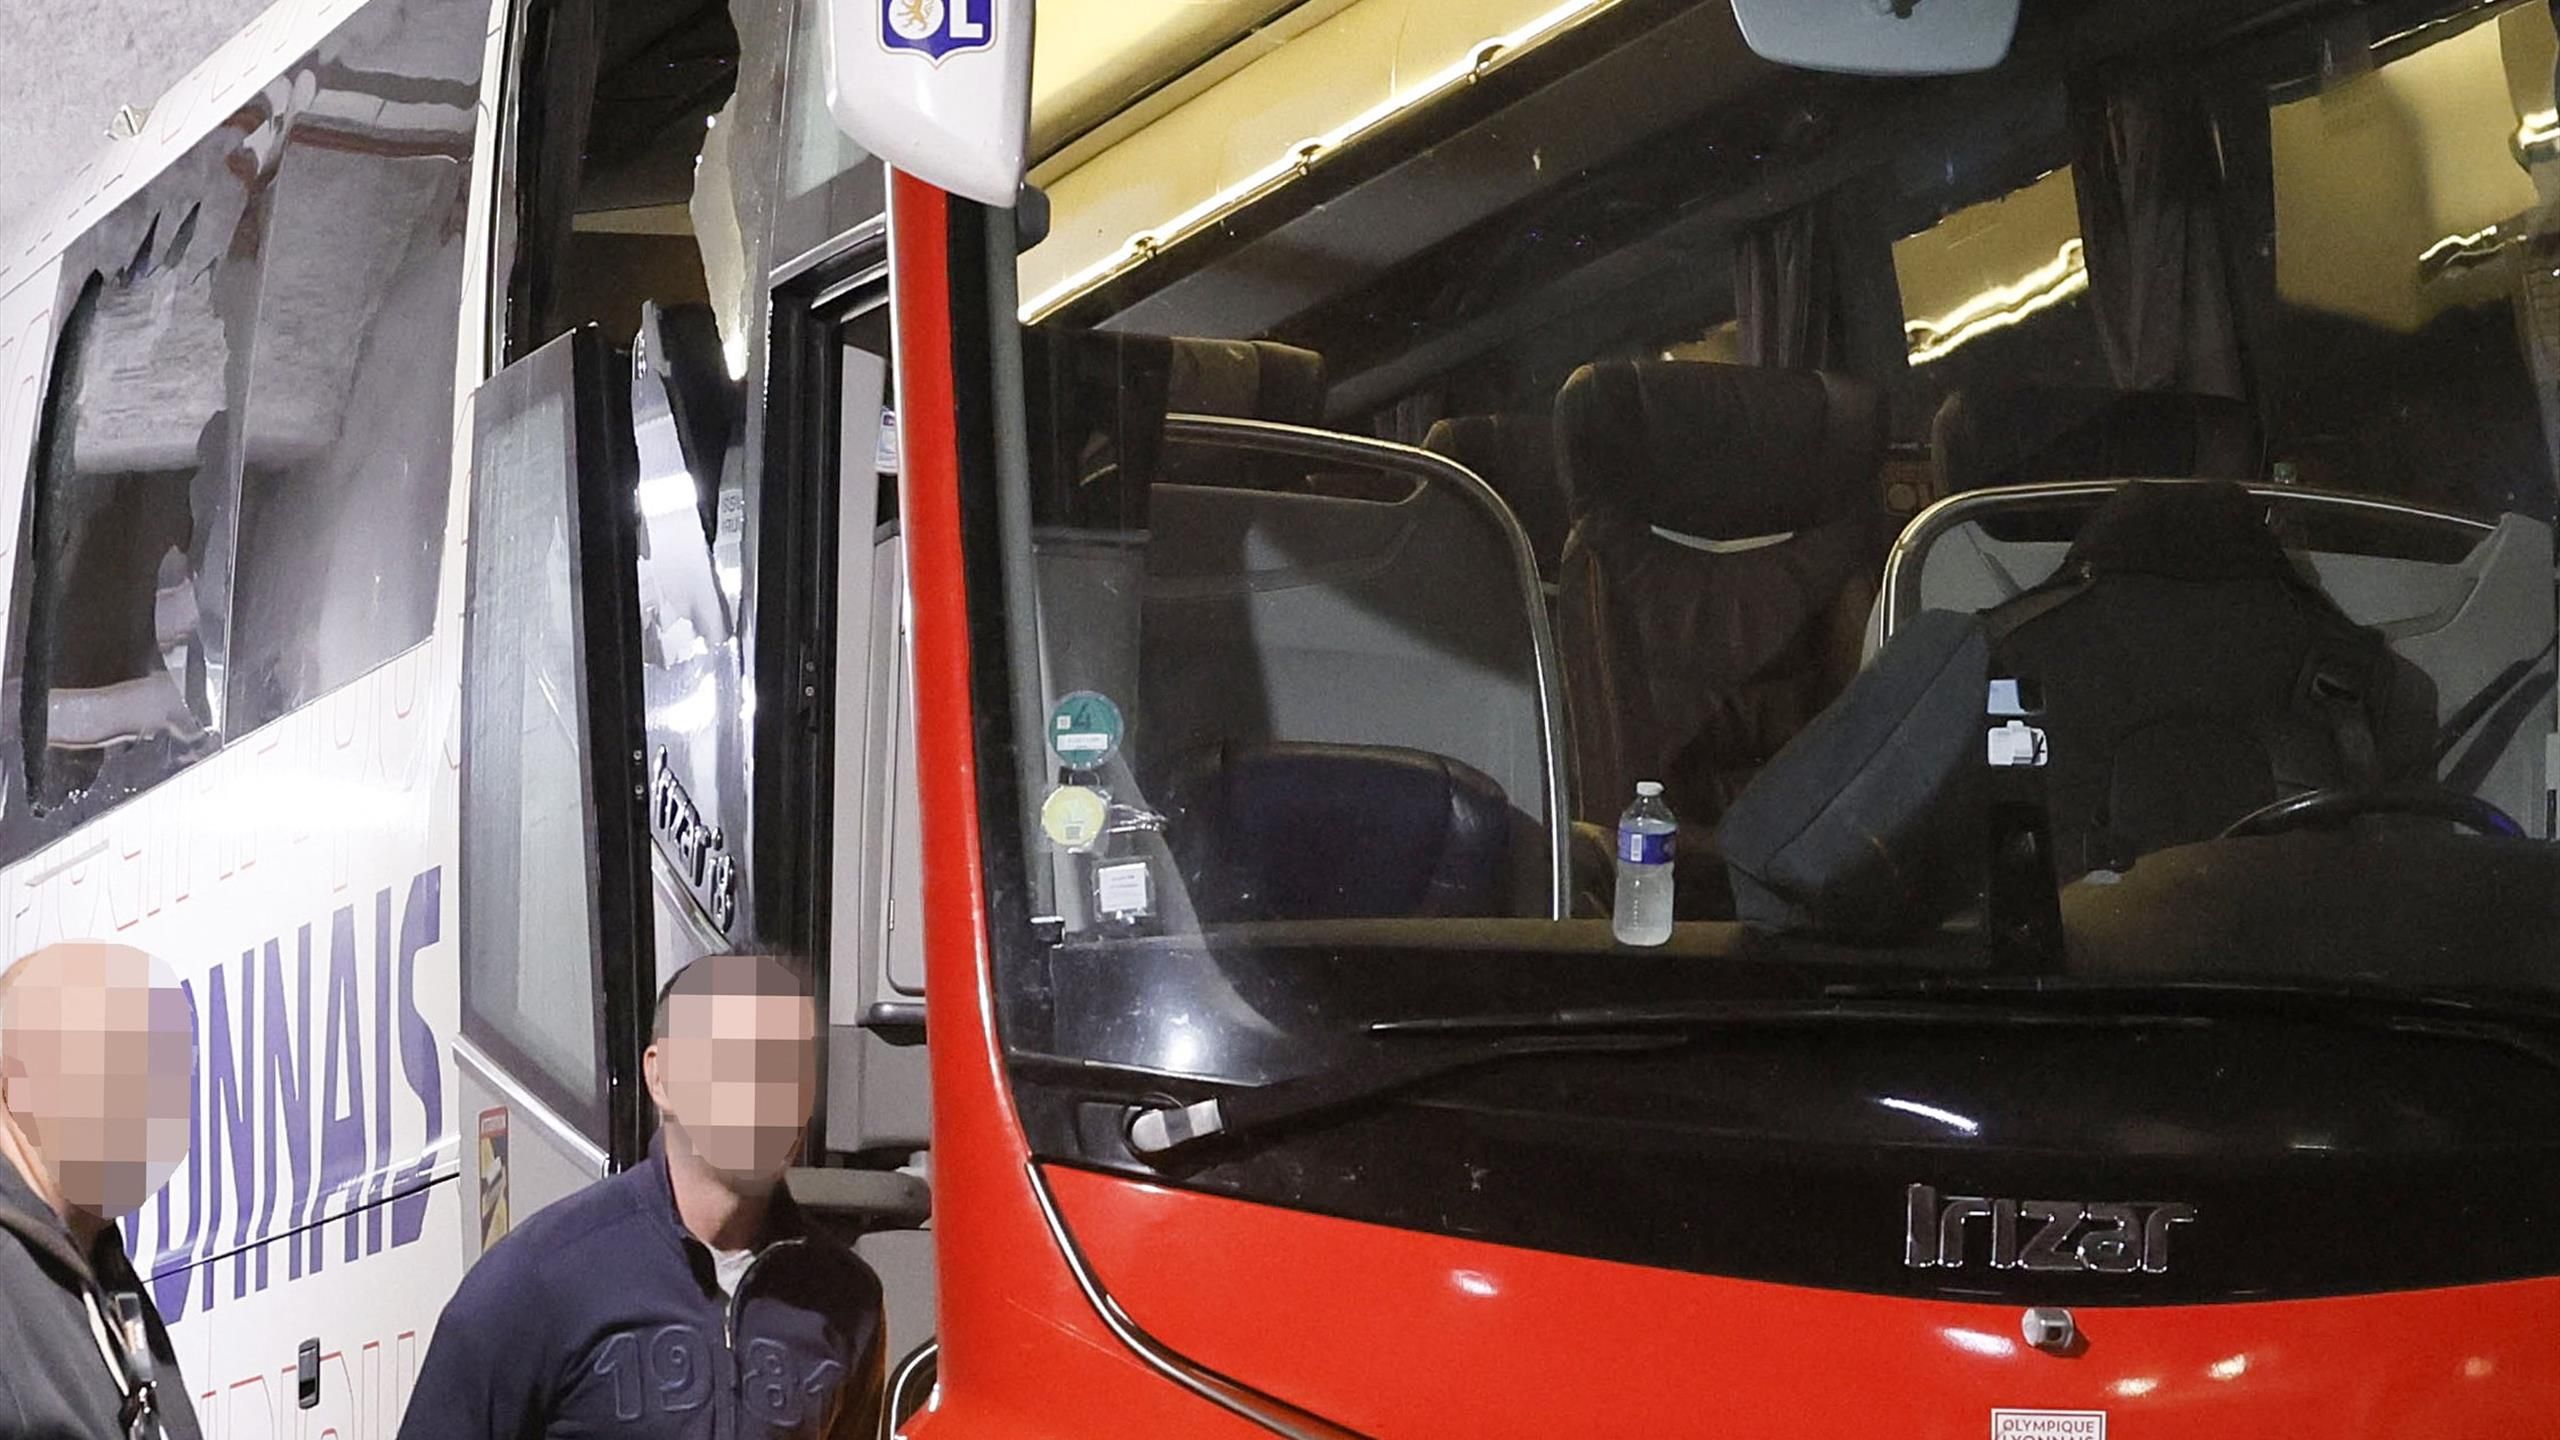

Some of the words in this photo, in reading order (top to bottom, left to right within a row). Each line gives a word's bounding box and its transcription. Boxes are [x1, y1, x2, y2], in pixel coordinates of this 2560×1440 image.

[125, 865, 442, 1326] ONNAIS
[1904, 1182, 2197, 1272] Irizar
[2002, 1419, 2095, 1433] OLYMPIQUE
